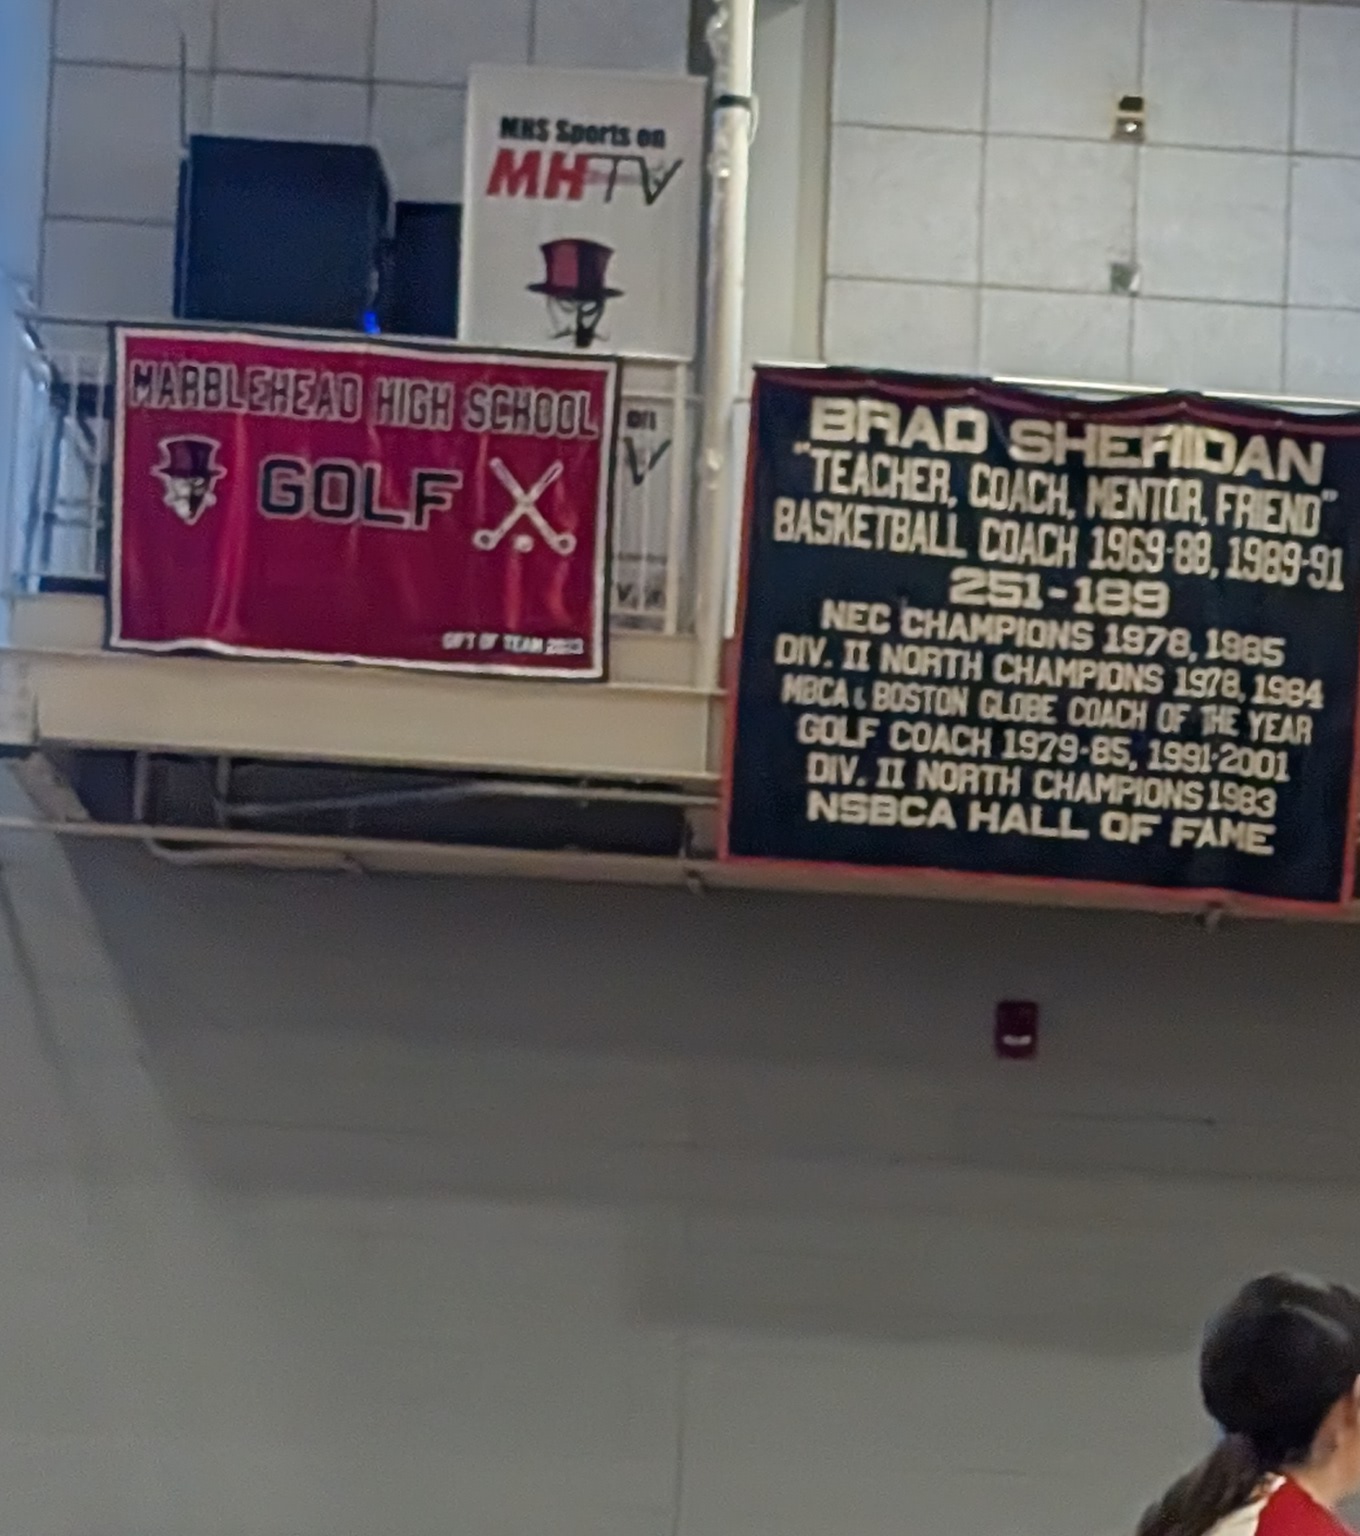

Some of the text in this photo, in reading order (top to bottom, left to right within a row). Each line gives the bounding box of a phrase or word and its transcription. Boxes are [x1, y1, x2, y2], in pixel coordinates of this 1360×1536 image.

[501, 116, 666, 149] MHS Sports on
[486, 148, 683, 206] MHTV
[129, 359, 598, 440] MARBLEHEAD HIGH SCHOOL
[810, 396, 1325, 486] BRAD SHERIDAN
[259, 454, 463, 531] GOLF
[969, 462, 1076, 520] COACH,
[1086, 475, 1208, 526] MENTOR,
[773, 496, 968, 558] BASKETBALL
[978, 517, 1079, 568] COACH
[1225, 536, 1344, 592] 1989-91
[774, 633, 833, 669] DIV.
[841, 639, 871, 672] II
[879, 642, 983, 681] NORTH
[992, 653, 1165, 694] CHAMPIONS
[821, 598, 891, 634] NEC
[900, 606, 1095, 652] CHAMPIONS
[1101, 622, 1197, 663] 1978,
[781, 673, 849, 708] MBCA
[871, 680, 969, 717] BOSTON
[978, 689, 1058, 725] GLOBE
[1067, 696, 1148, 730] COACH
[1157, 702, 1191, 733] OF
[1200, 704, 1241, 736] THE
[1248, 711, 1313, 745] YEAR
[797, 713, 1290, 782] GOLF COACH 1979-85, 1991-2001
[806, 752, 1278, 818] DIV. II NORTH CHAMPIONS 1983
[806, 790, 1277, 856] NSBCA HALL OF FAME
